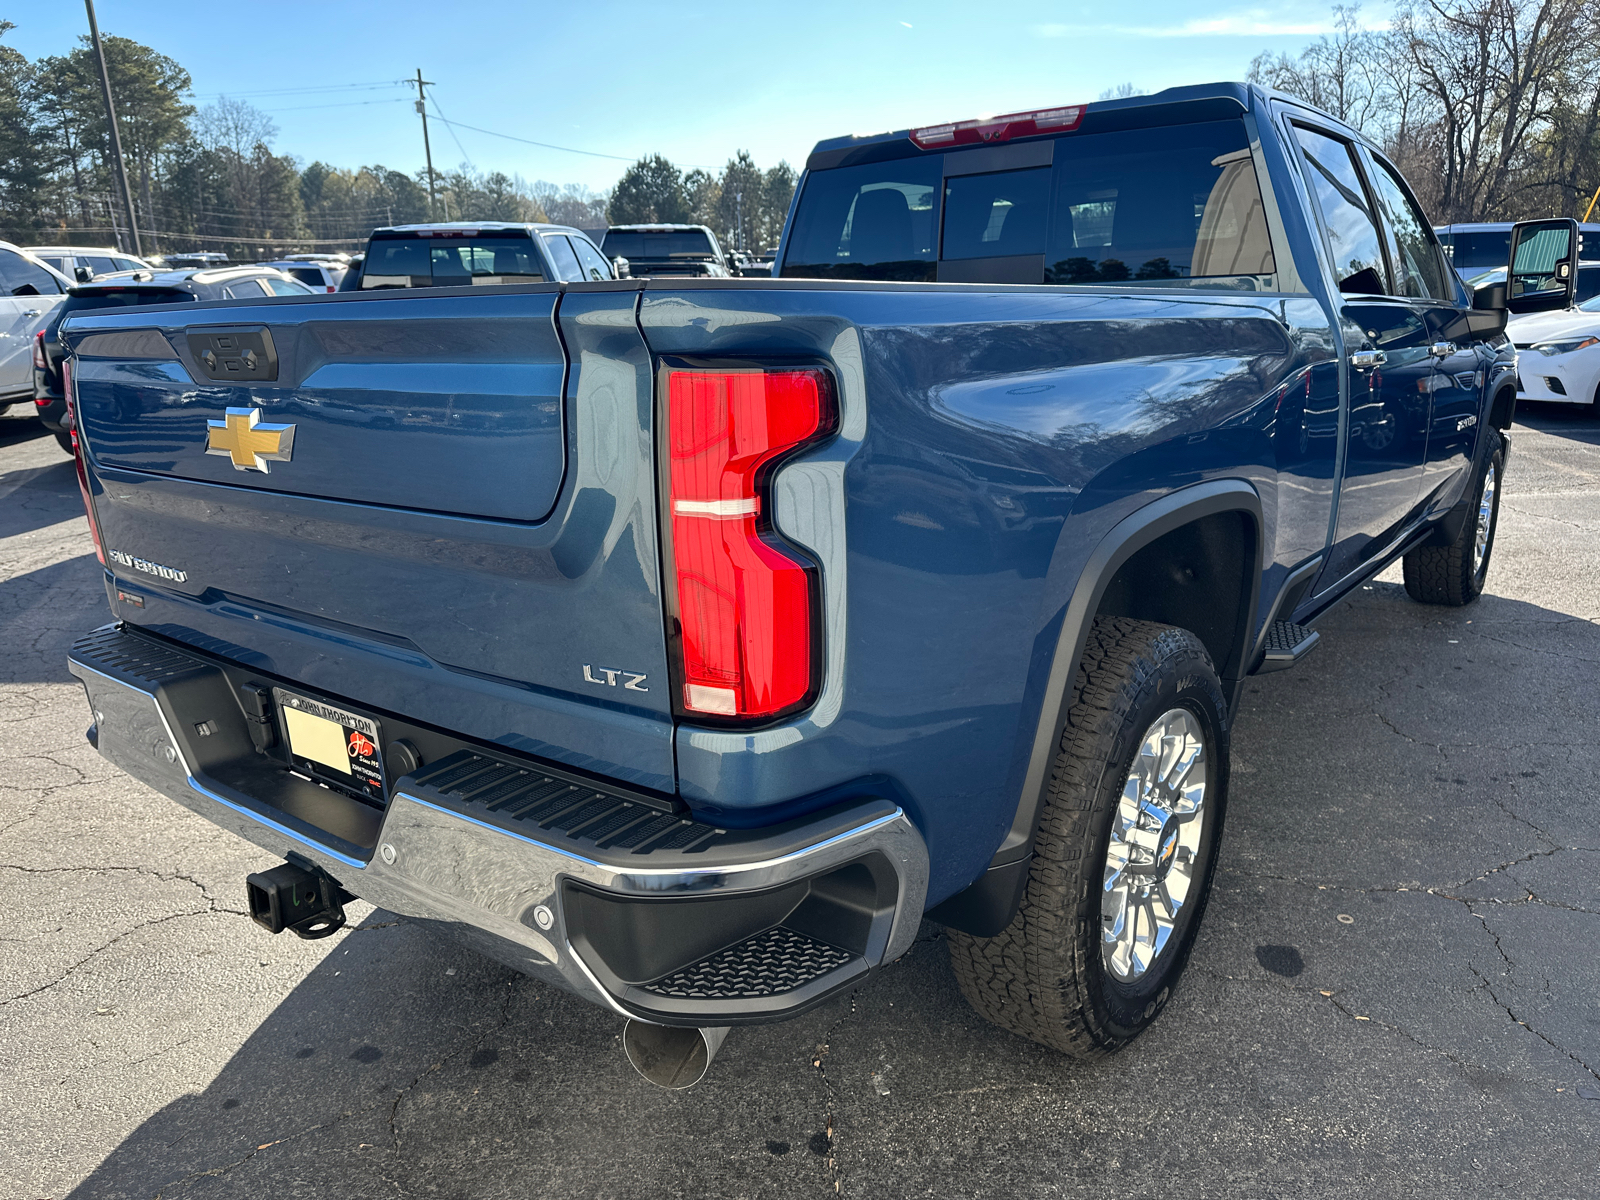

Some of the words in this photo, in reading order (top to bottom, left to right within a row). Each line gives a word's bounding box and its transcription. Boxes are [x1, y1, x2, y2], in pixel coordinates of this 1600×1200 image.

[582, 662, 649, 692] LTZ
[298, 700, 320, 714] JOHN
[321, 706, 372, 733] THORNTON
